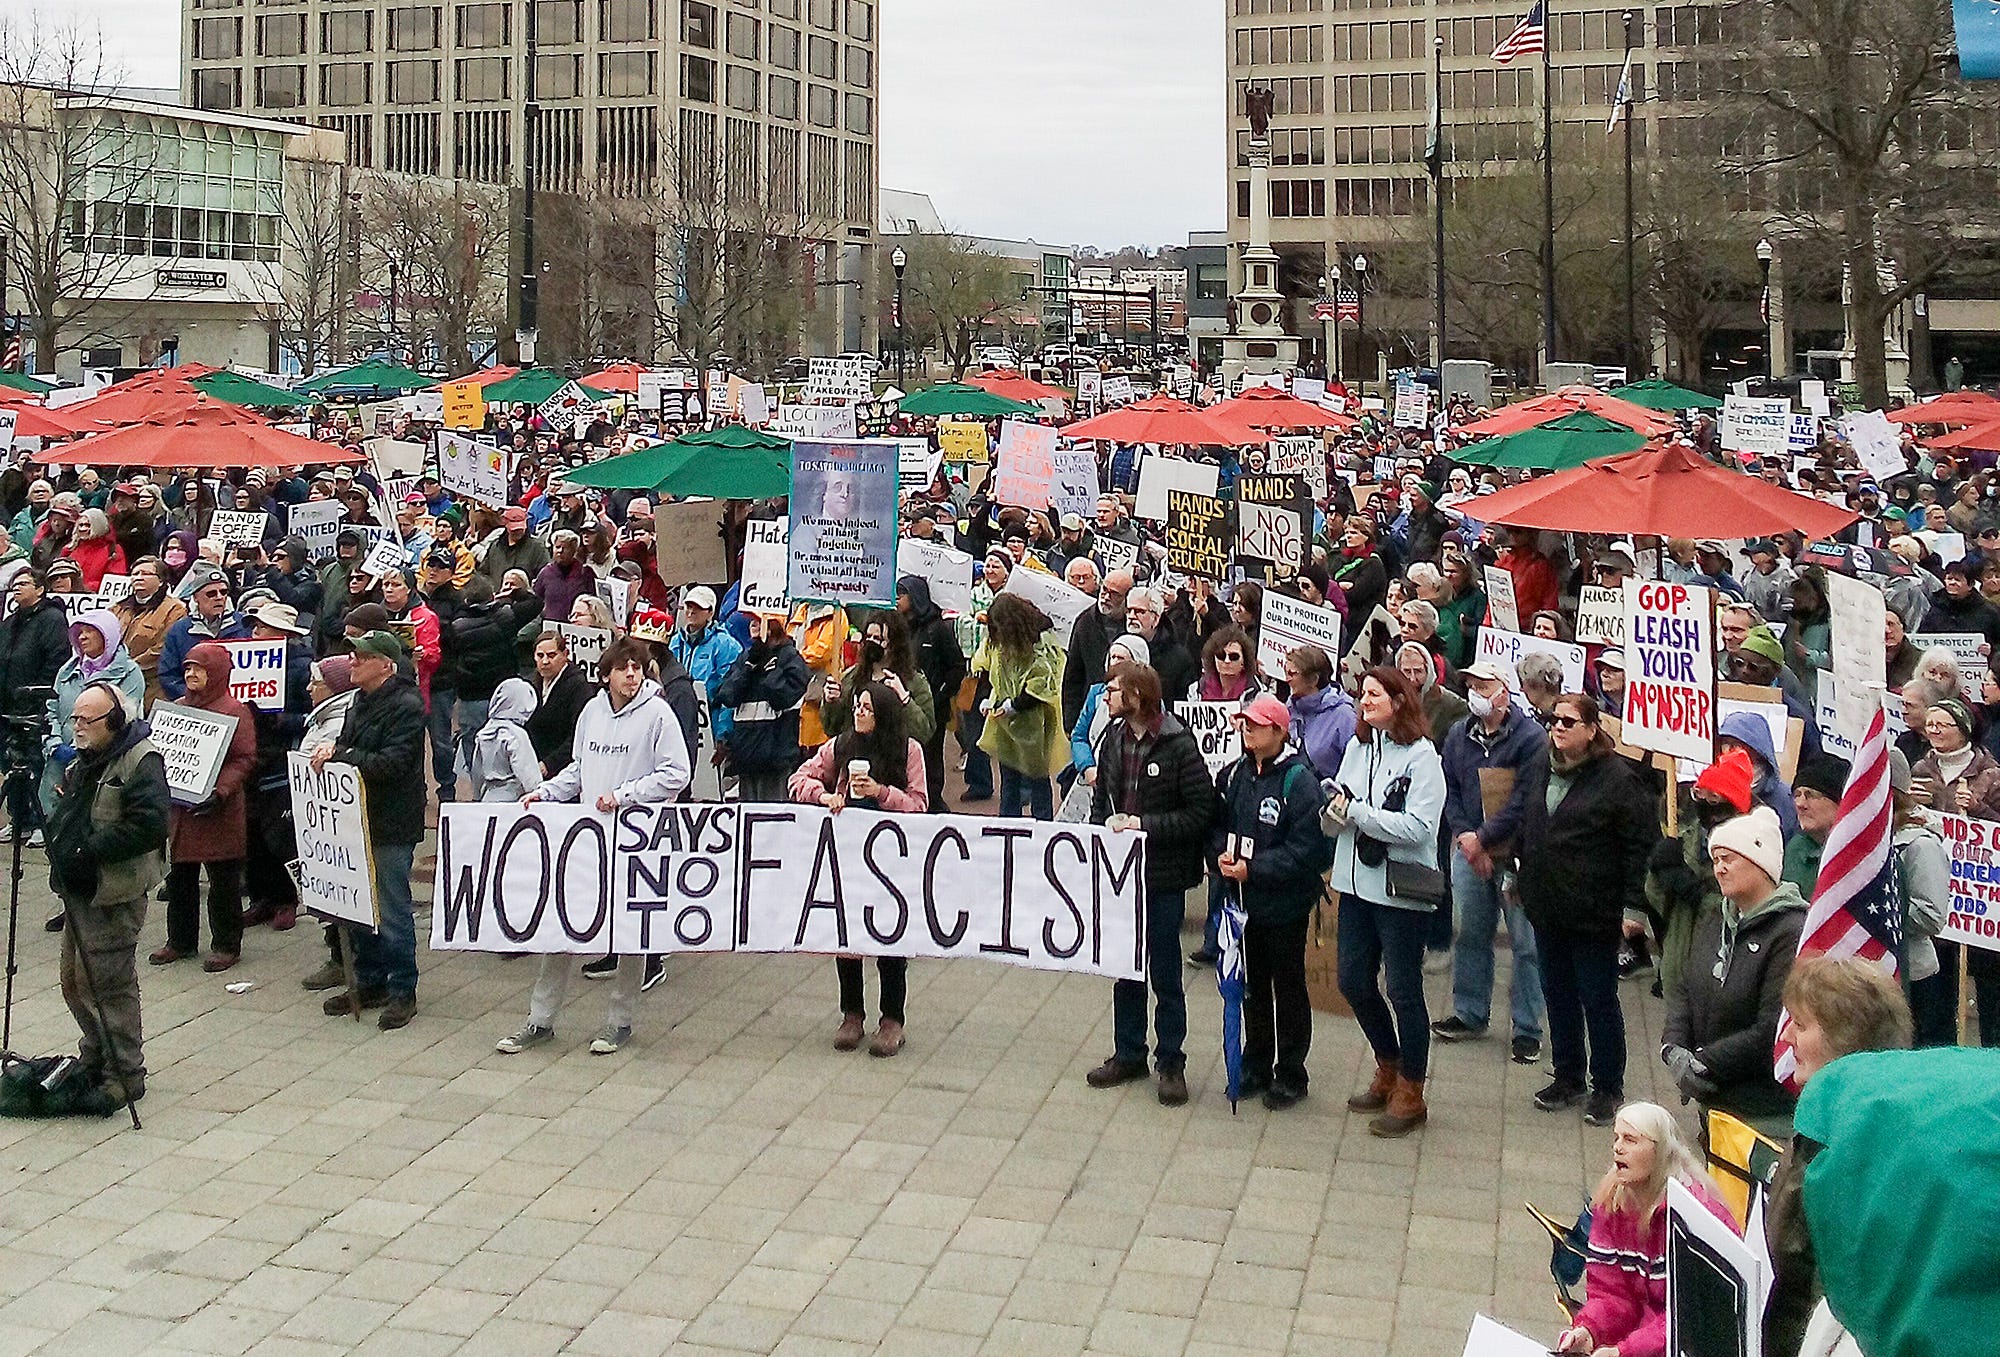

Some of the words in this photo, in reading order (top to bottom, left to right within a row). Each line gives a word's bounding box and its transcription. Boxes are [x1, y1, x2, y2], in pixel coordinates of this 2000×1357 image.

[810, 368, 859, 378] AMERICA
[811, 360, 839, 368] WAKE
[844, 361, 858, 369] UP
[810, 386, 859, 396] TAKEOVER
[554, 397, 592, 429] PROCESS
[1794, 415, 1812, 427] BE
[1278, 440, 1316, 458] DUMP
[1240, 477, 1295, 501] HANDS
[217, 513, 261, 524] HANDS
[1169, 491, 1225, 519] HANDS
[222, 523, 250, 535] OFF
[290, 521, 337, 537] UNITED
[750, 522, 790, 545] Hate
[822, 527, 834, 537] all
[1179, 511, 1212, 534] OFF
[1257, 509, 1291, 537] NO
[1092, 537, 1132, 558] ANDS
[1169, 528, 1228, 559] SOCIAL
[1242, 526, 1299, 562] KING
[1168, 548, 1232, 580] SECURITY
[743, 582, 789, 609] Great
[1638, 584, 1692, 616] GOP:
[1271, 598, 1292, 614] LET'S
[1294, 606, 1330, 626] PROTECT
[1265, 611, 1283, 624] OUR
[1283, 619, 1334, 641] DEMOCRACY
[1634, 615, 1701, 652] LEASH
[558, 629, 606, 652] eport
[1933, 638, 1974, 648] PROTECT
[232, 647, 283, 669] UTH
[1638, 647, 1697, 683] YOUR
[230, 680, 278, 700] TTERS
[1627, 681, 1711, 742] MONSTER
[152, 729, 200, 749] EDUCATION
[1201, 729, 1236, 755] OFF
[292, 763, 355, 805] HANDS
[306, 800, 341, 836] OFF
[617, 805, 735, 853] SAYS
[1942, 817, 1985, 847] NDS
[302, 829, 357, 872] SOCIAL
[1952, 841, 1994, 866] OUR
[441, 813, 608, 944] WOO
[627, 855, 720, 899] NO
[738, 812, 1144, 974] FASCISM
[1950, 894, 1988, 916] OOD
[626, 901, 713, 950] TO
